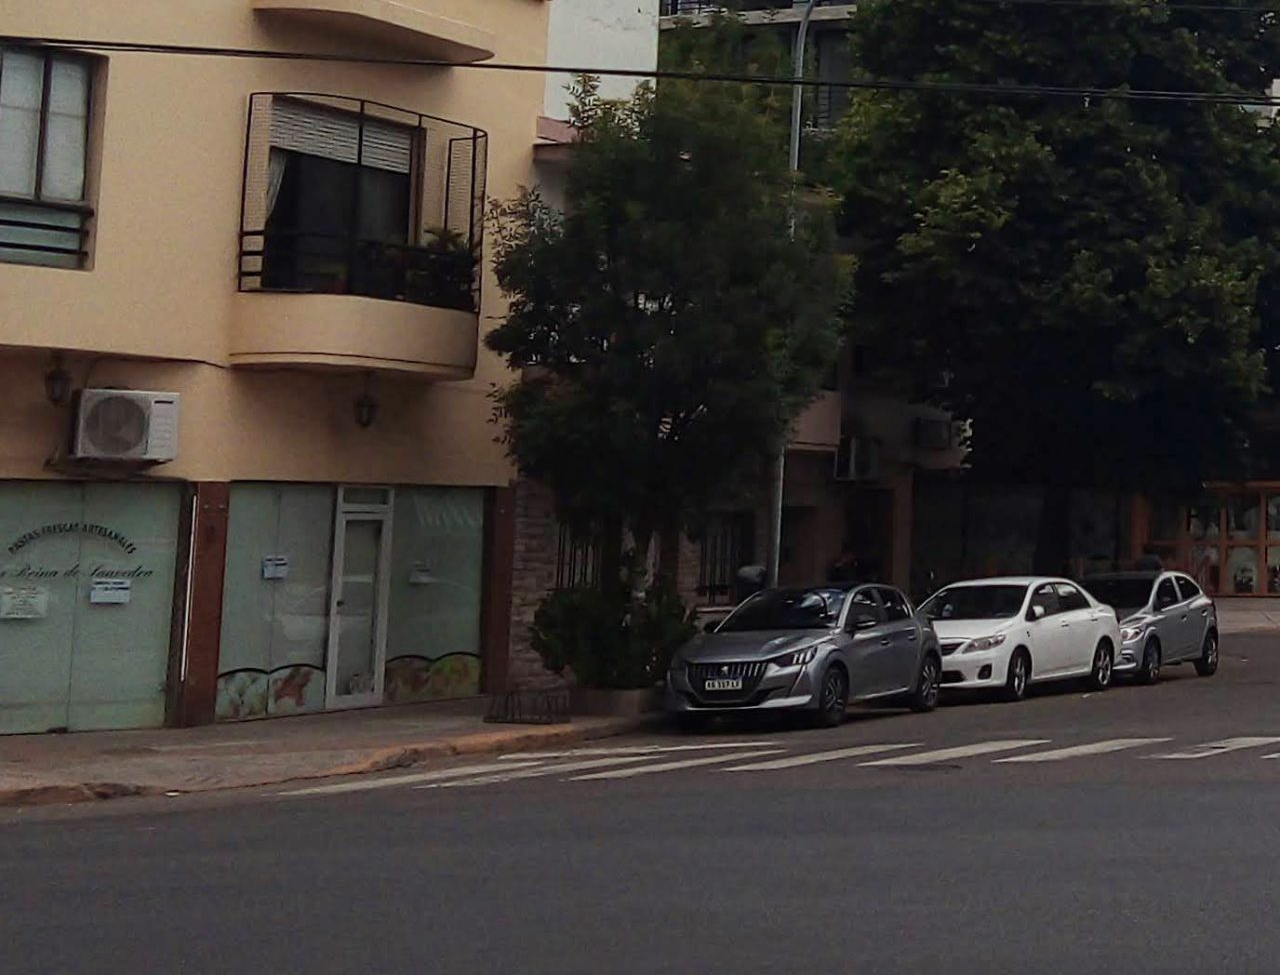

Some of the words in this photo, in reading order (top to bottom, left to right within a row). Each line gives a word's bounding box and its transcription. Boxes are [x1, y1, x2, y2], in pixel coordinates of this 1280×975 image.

[8, 529, 40, 554] PASTAS
[41, 522, 79, 534] FRESCAS
[81, 524, 136, 554] ARTESANALES
[16, 563, 58, 578] Reina
[63, 563, 80, 577] de
[91, 564, 154, 578] Saavedra
